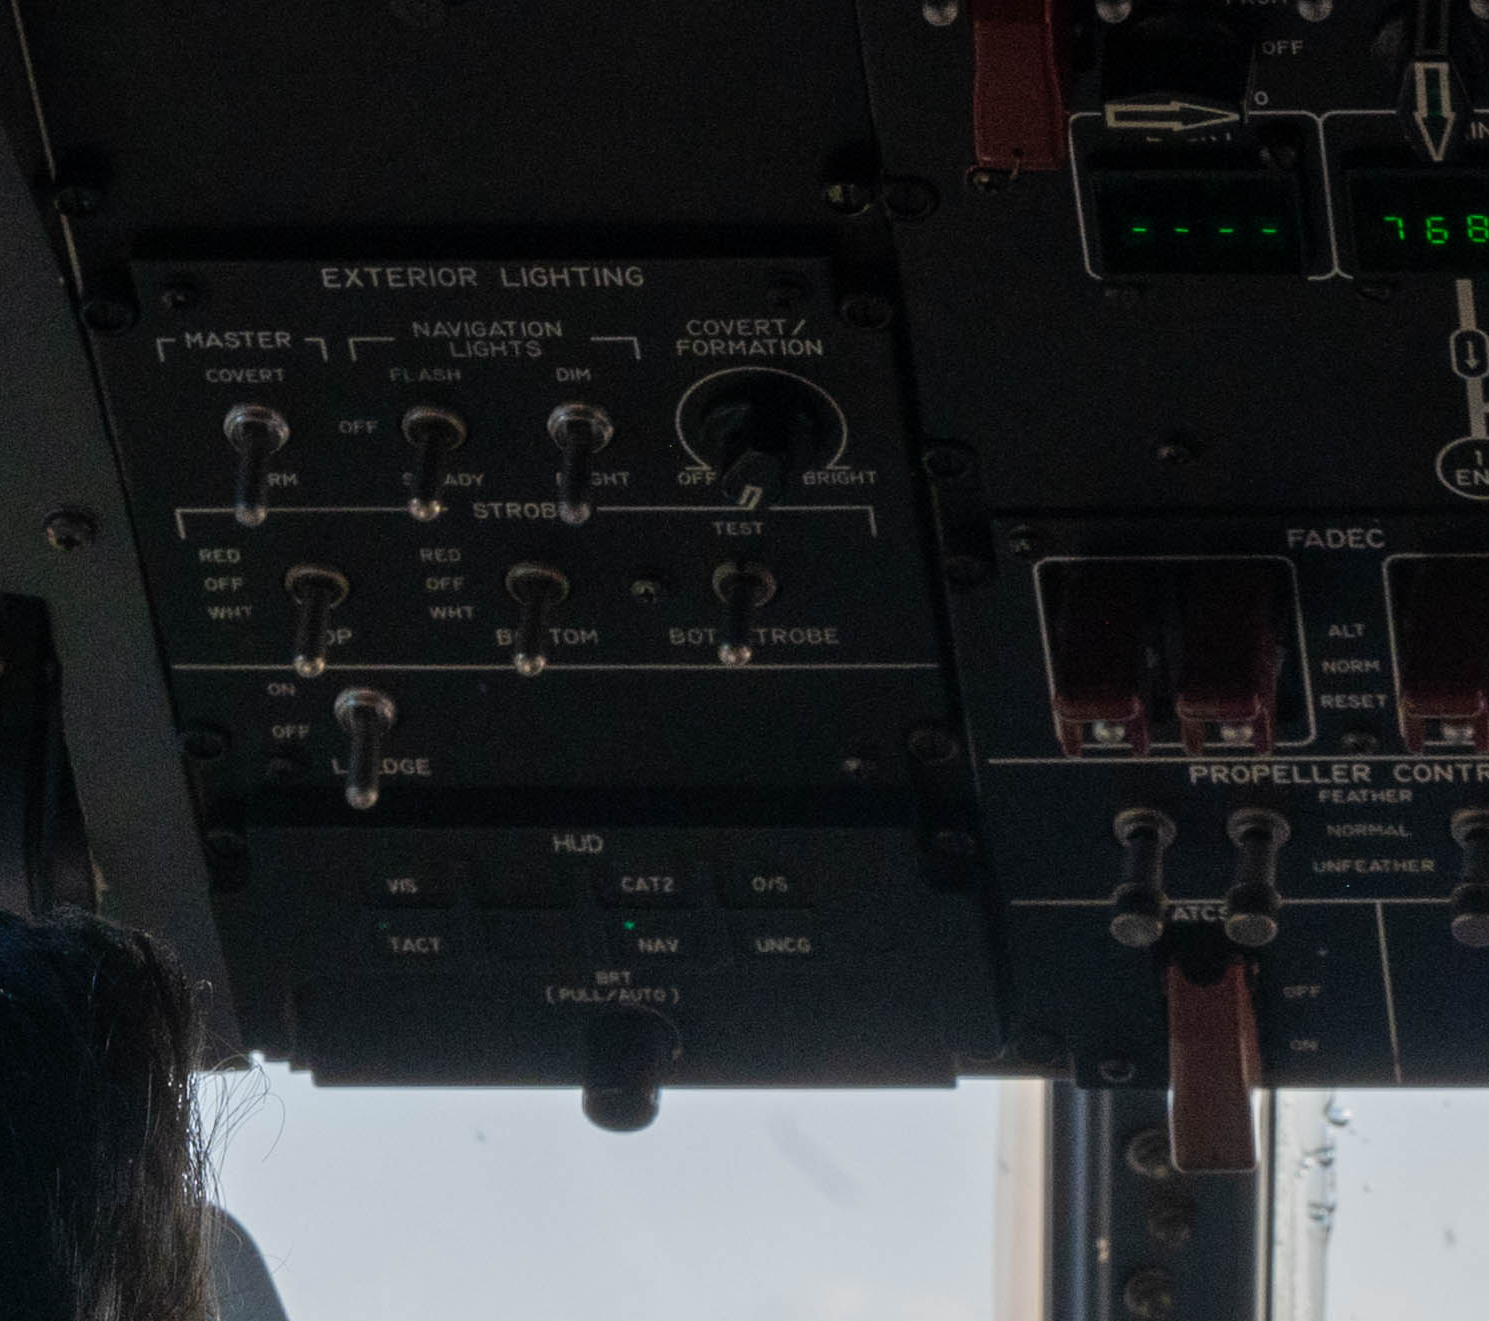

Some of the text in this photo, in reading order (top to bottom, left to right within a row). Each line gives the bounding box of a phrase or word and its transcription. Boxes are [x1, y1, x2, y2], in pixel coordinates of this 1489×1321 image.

[1262, 40, 1304, 56] OFF
[321, 265, 645, 289] EXTERIOR LIGHTING
[412, 320, 563, 339] NAVIGATION
[185, 331, 292, 350] MASTER
[675, 338, 823, 357] FORMATION
[450, 340, 543, 359] LIGHTS
[205, 367, 285, 384] COVERT
[389, 366, 462, 383] FLASH
[556, 367, 591, 383] DIM
[338, 419, 378, 435] OFF
[678, 472, 717, 486] OFF
[803, 470, 878, 486] BRIGHT
[713, 521, 763, 536] TEST
[1286, 528, 1385, 550] FADEC
[199, 549, 241, 564] RED
[419, 548, 462, 563] RED
[204, 576, 243, 592] OFF
[425, 576, 464, 592] OFF
[207, 605, 252, 620] WHT
[429, 605, 474, 620] WHT
[1328, 623, 1365, 639] ALT
[1321, 659, 1380, 674] NORM
[1320, 693, 1388, 710] RESET
[272, 724, 310, 740] OFF
[1188, 763, 1372, 786] PROPELLER
[1318, 788, 1413, 804] FEATHER
[1326, 823, 1411, 838] NORMAL
[553, 834, 604, 854] HUD
[1313, 858, 1435, 874] UNFEATHER
[387, 876, 418, 894] VIS
[621, 876, 675, 894] CAT2
[388, 937, 442, 955] TACT
[638, 937, 679, 954] NAV
